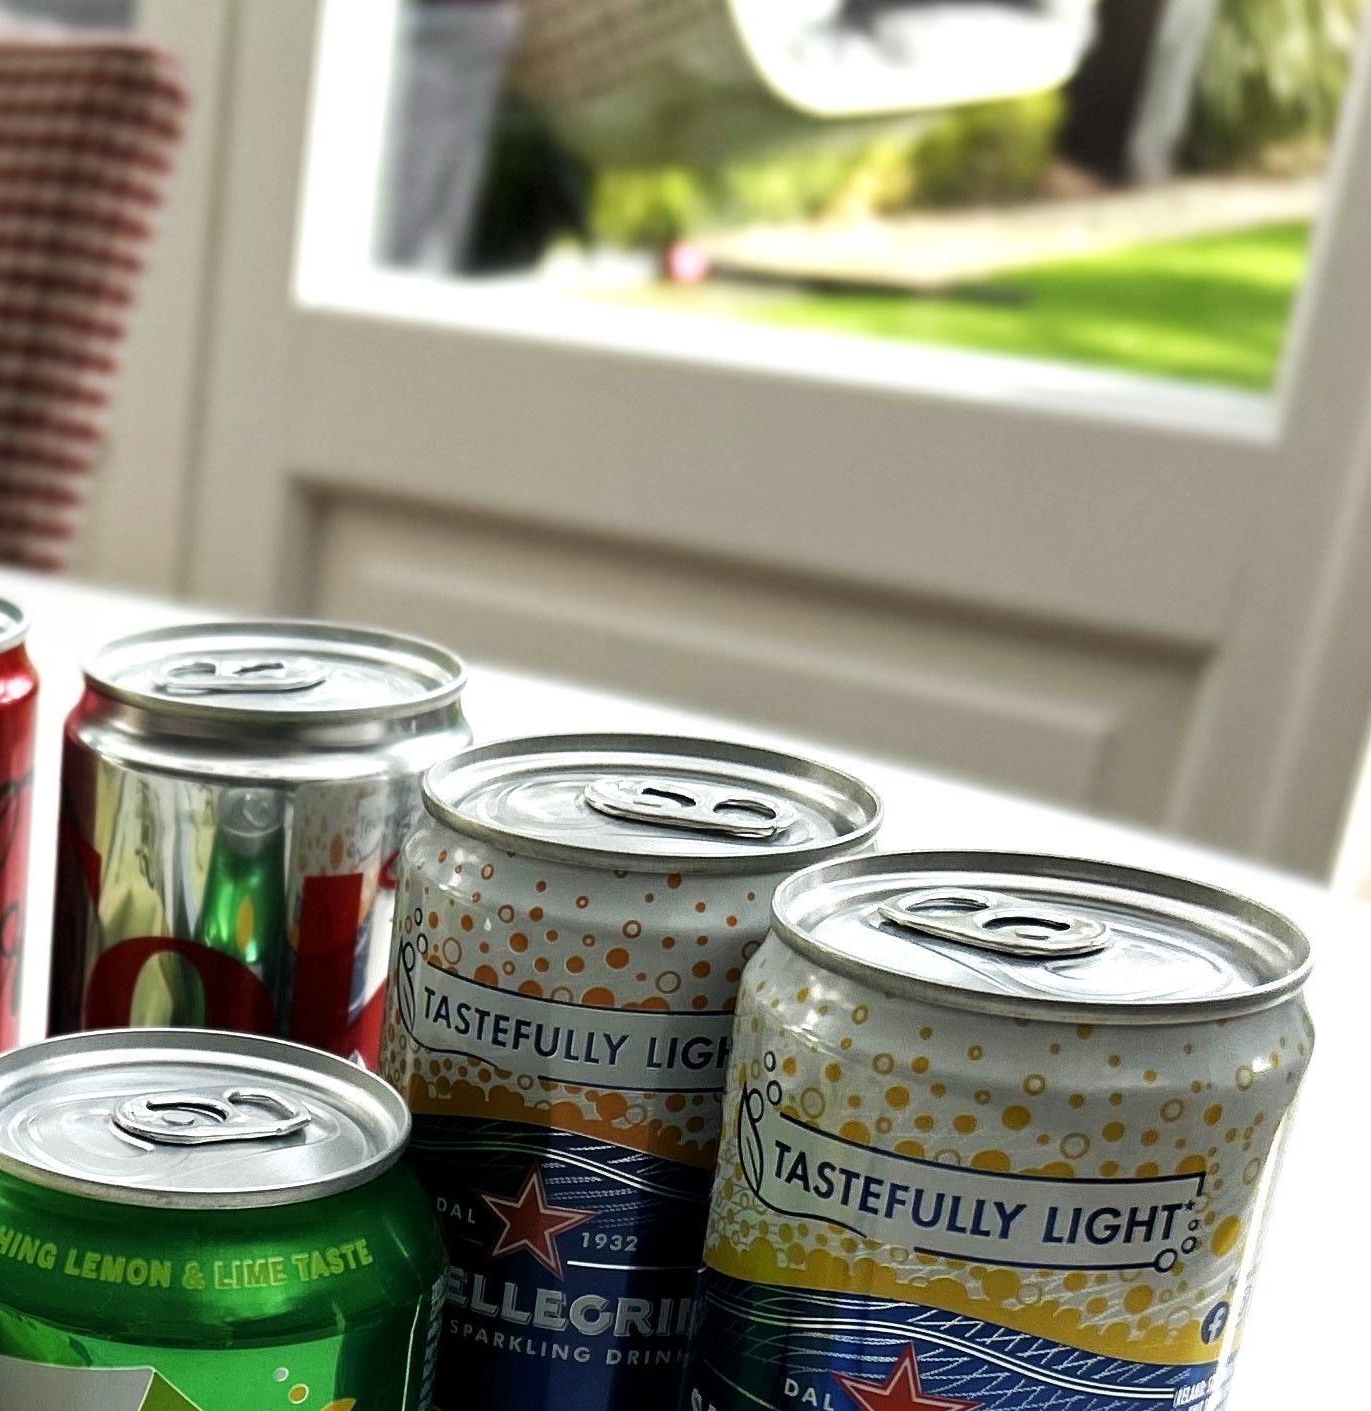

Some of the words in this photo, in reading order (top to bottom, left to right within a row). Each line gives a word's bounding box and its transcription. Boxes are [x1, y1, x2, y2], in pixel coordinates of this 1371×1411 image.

[423, 985, 629, 1068] TASTEFULLY
[773, 1139, 1027, 1241] TASTEFULLY
[436, 1196, 477, 1225] DAL
[580, 1230, 640, 1253] 1932
[64, 1247, 172, 1289] LEMON
[182, 1262, 205, 1290] &
[213, 1254, 288, 1290] LIME
[292, 1238, 374, 1281] TASTE
[449, 1318, 591, 1363] SPARKLING
[605, 1349, 693, 1369] DRIN
[783, 1378, 836, 1411] DAL
